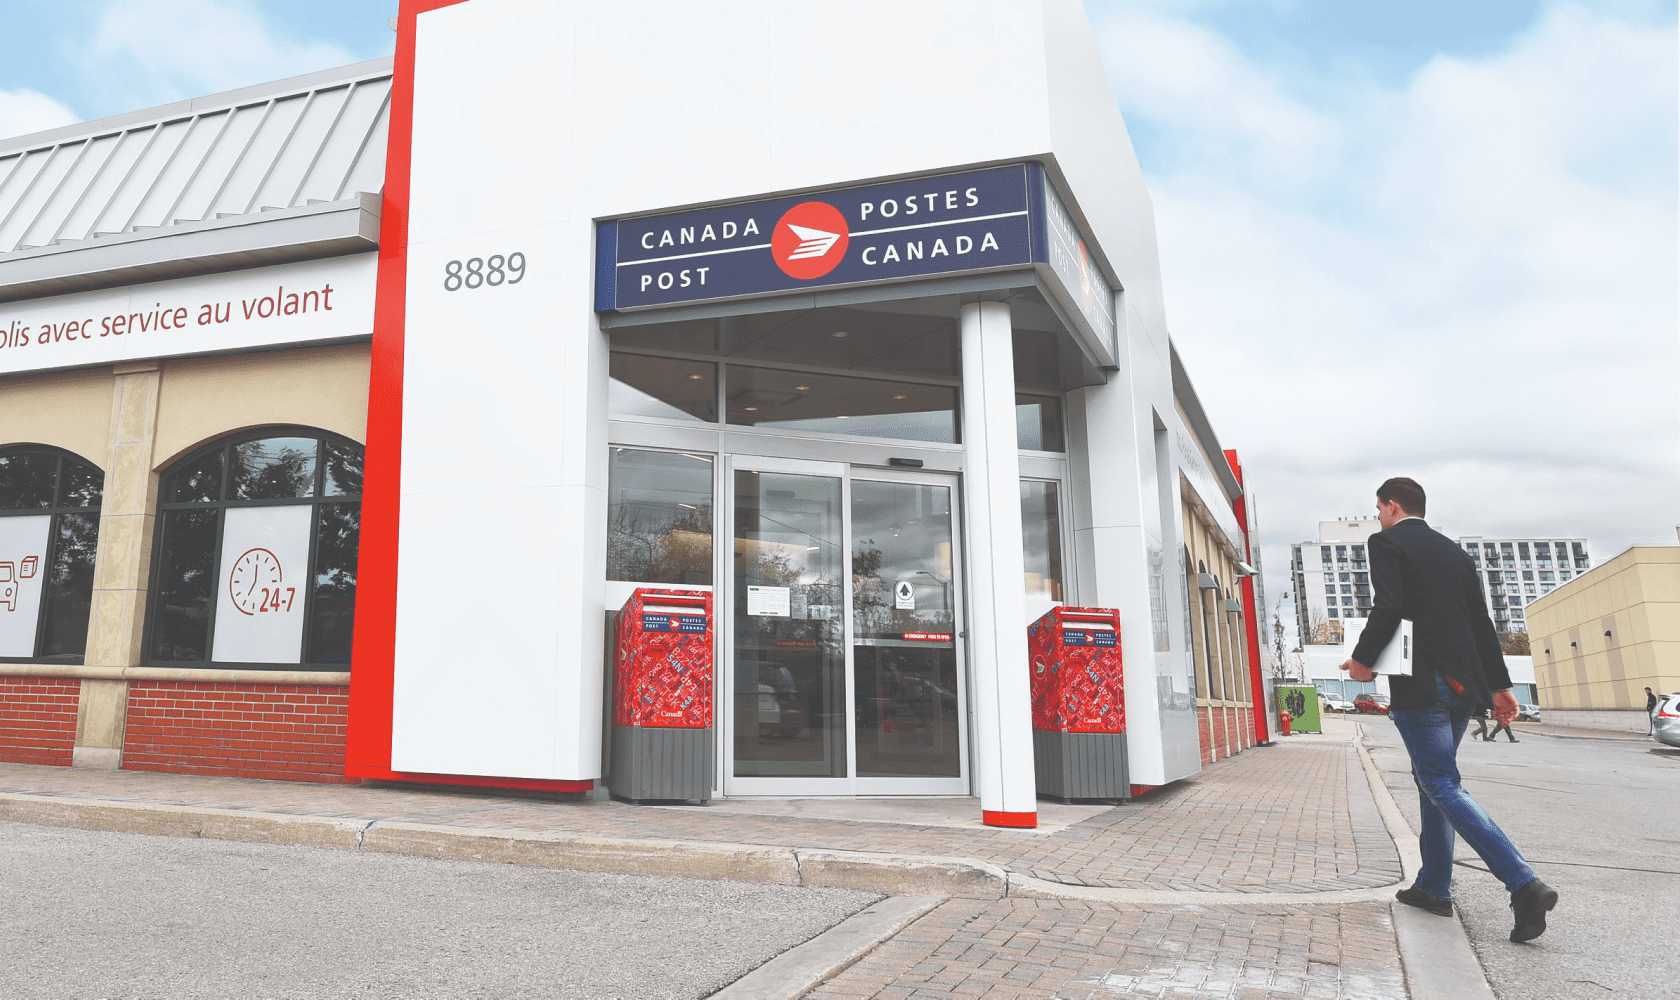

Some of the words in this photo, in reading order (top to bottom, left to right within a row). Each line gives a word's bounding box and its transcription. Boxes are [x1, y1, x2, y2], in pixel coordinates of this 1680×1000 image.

[860, 187, 979, 221] POSTES
[641, 218, 760, 250] CANADA
[861, 232, 1000, 266] CANADA
[444, 251, 526, 291] 8889
[640, 267, 710, 292] POST
[37, 317, 93, 345] avec
[99, 302, 188, 338] service
[197, 301, 231, 326] au
[241, 284, 334, 320] volant
[259, 587, 296, 613] 24-7
